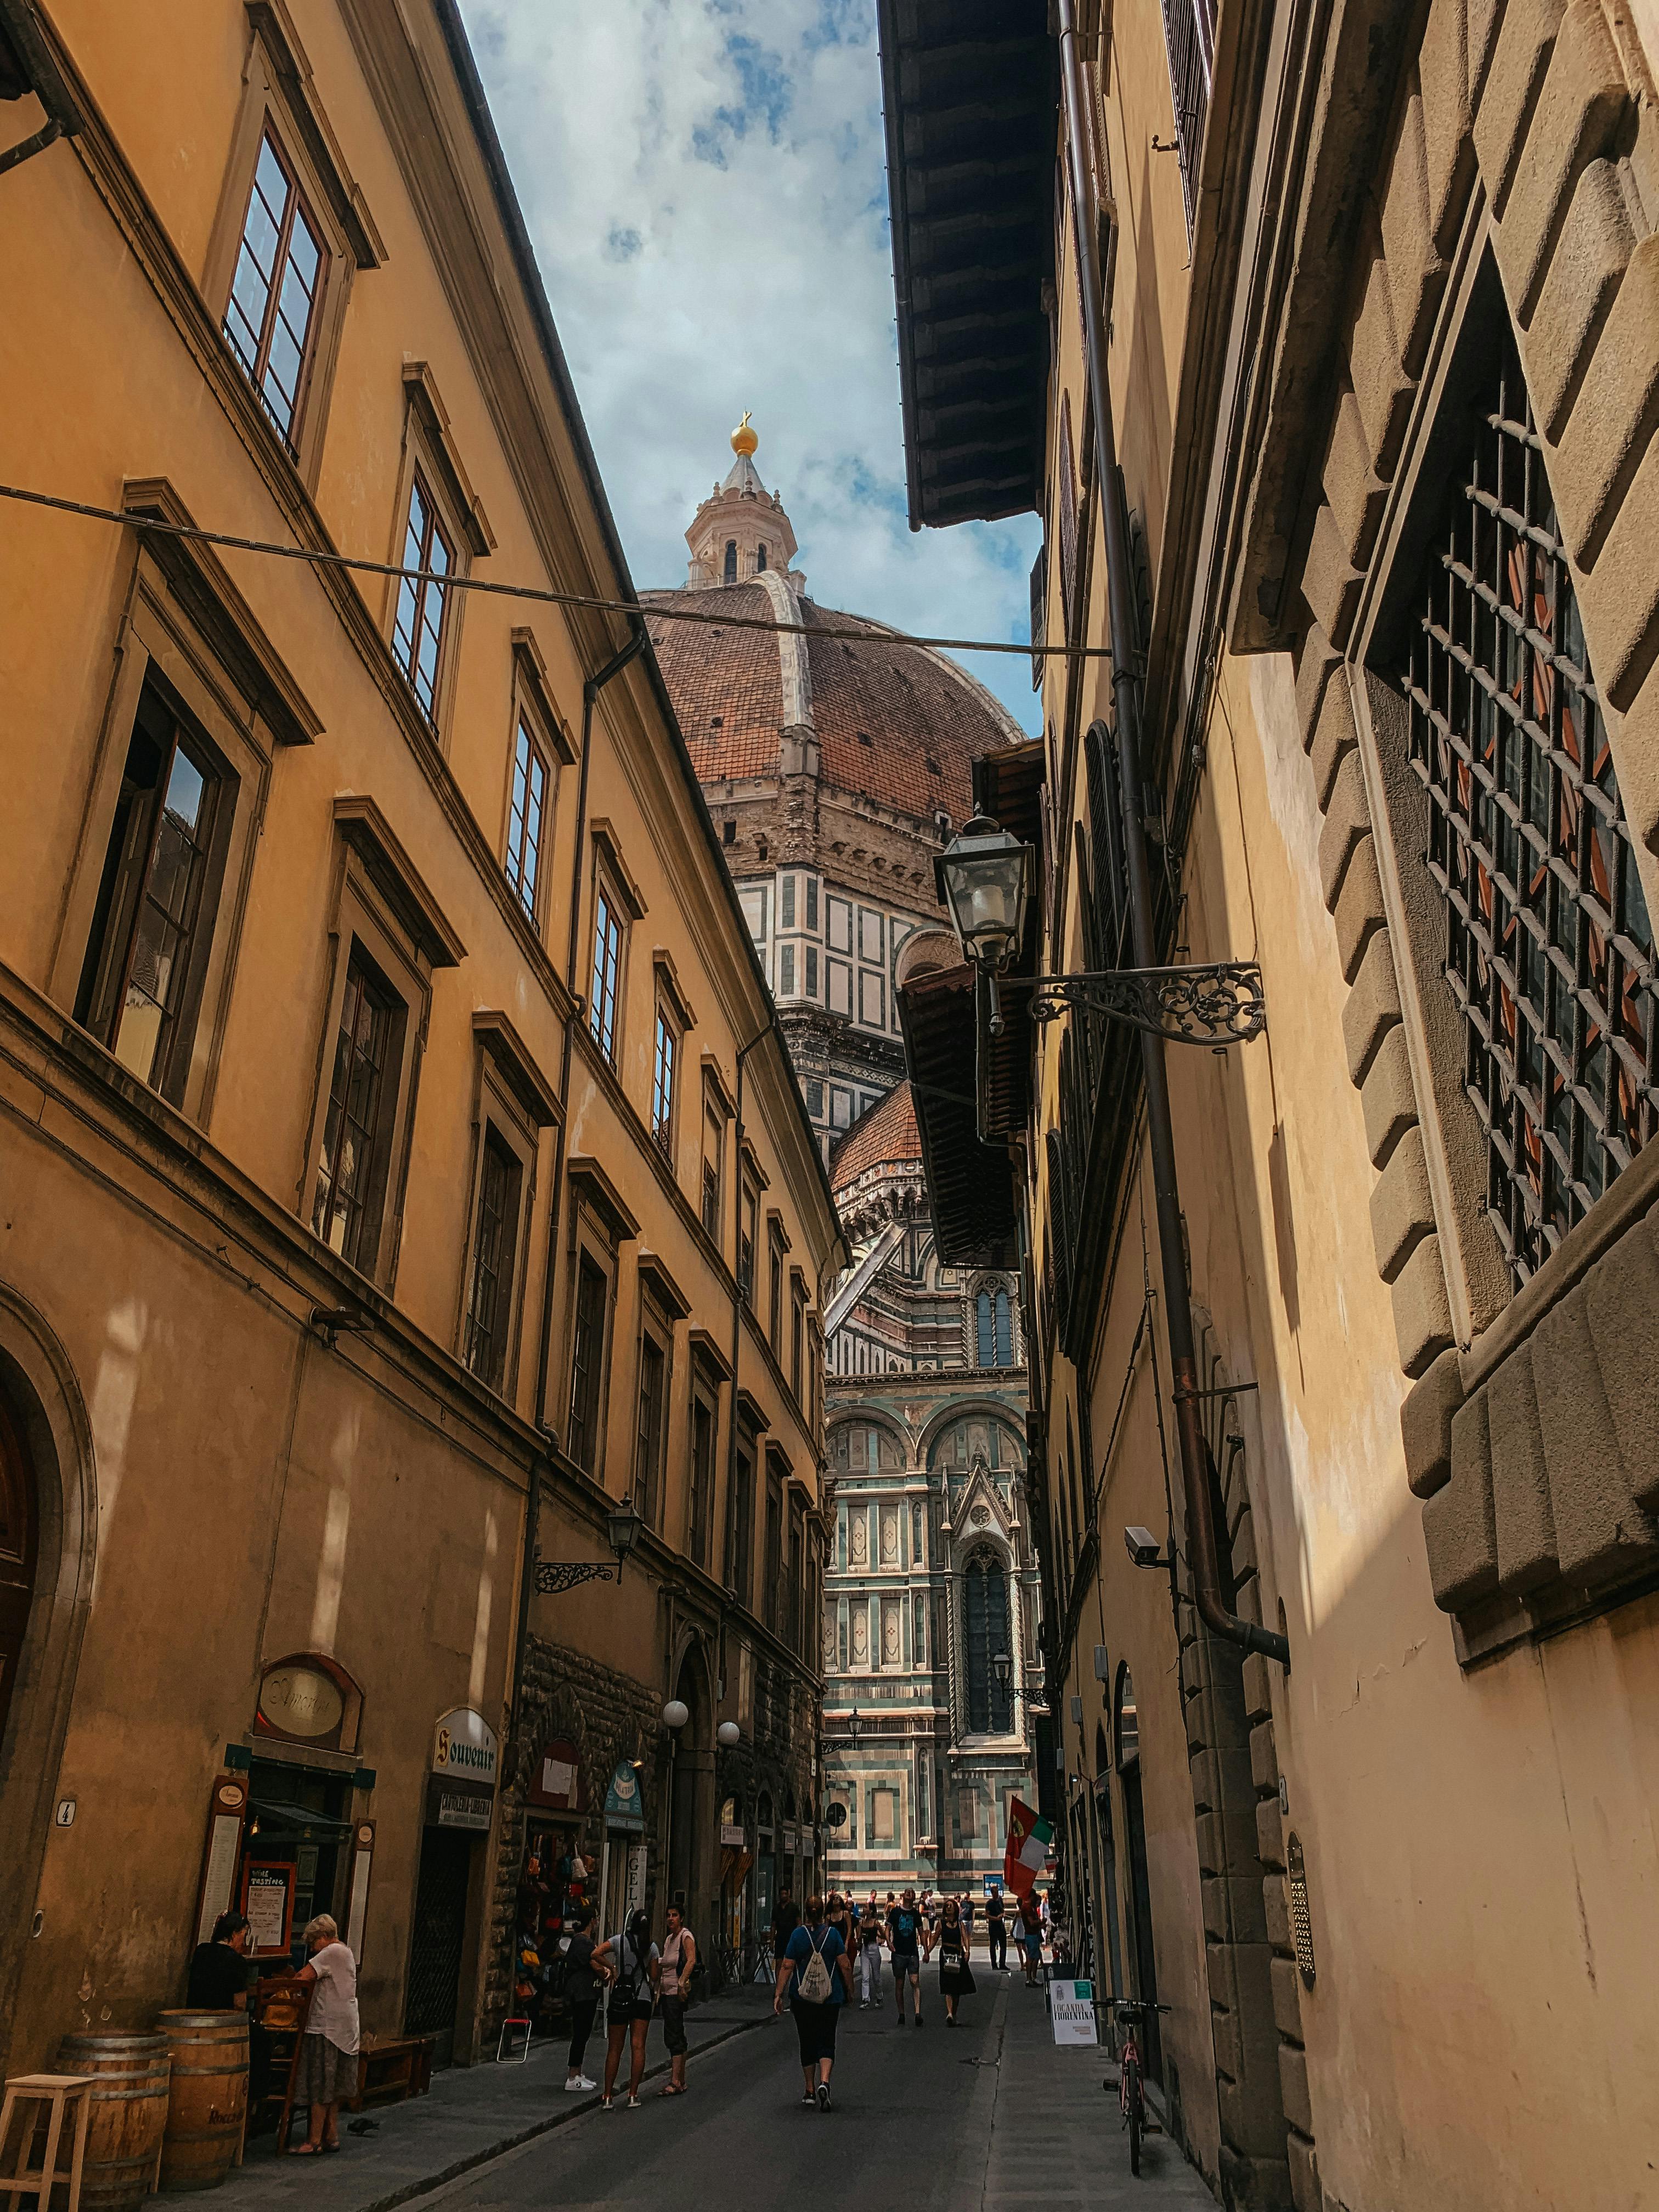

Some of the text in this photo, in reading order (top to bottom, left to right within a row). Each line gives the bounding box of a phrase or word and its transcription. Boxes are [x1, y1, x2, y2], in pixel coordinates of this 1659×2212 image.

[437, 1729, 494, 1771] Souvenir
[63, 1804, 70, 1822] 4
[1053, 2004, 1084, 2012] LOCANDA
[1054, 2011, 1093, 2020] FIORENTINA
